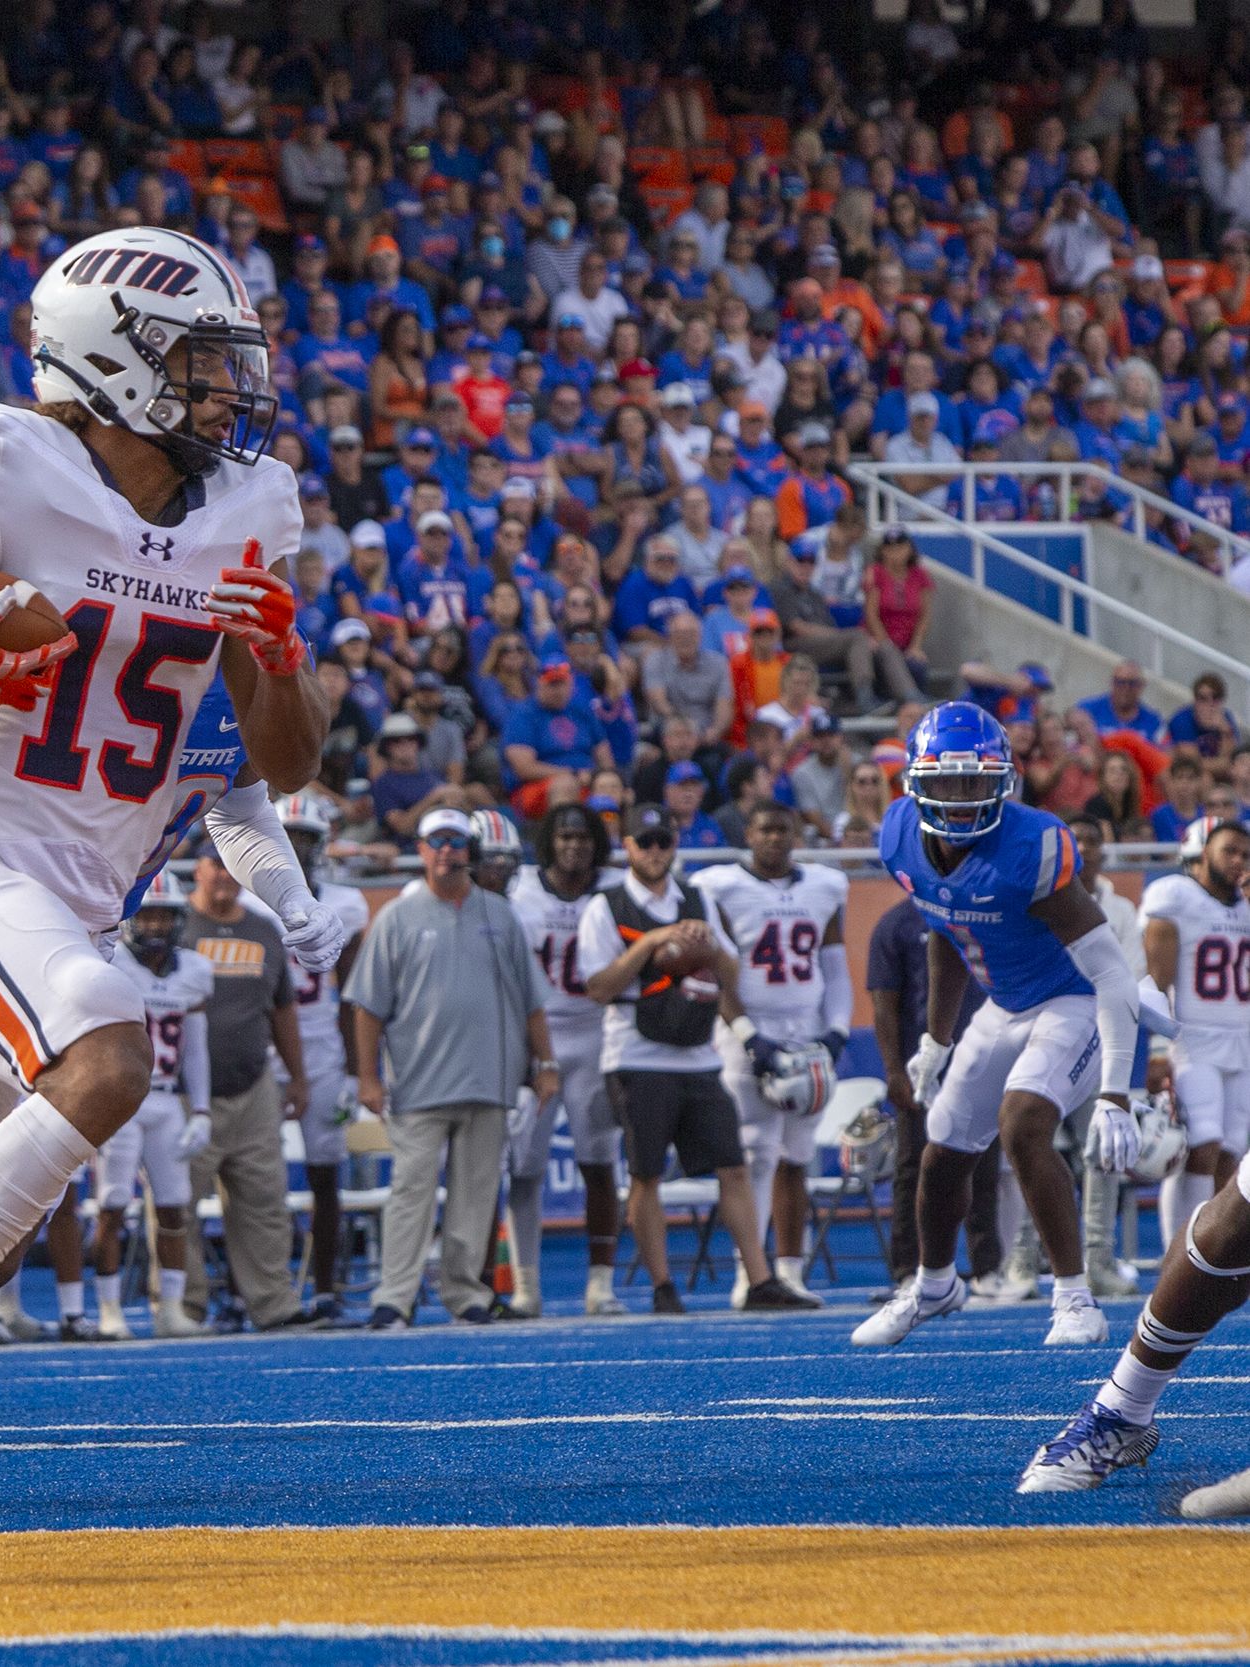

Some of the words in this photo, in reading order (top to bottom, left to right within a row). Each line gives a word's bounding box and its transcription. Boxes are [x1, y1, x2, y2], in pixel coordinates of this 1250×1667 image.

[67, 248, 200, 298] UTM
[14, 597, 223, 804] 15
[177, 746, 241, 766] STATE
[751, 920, 818, 985] 49
